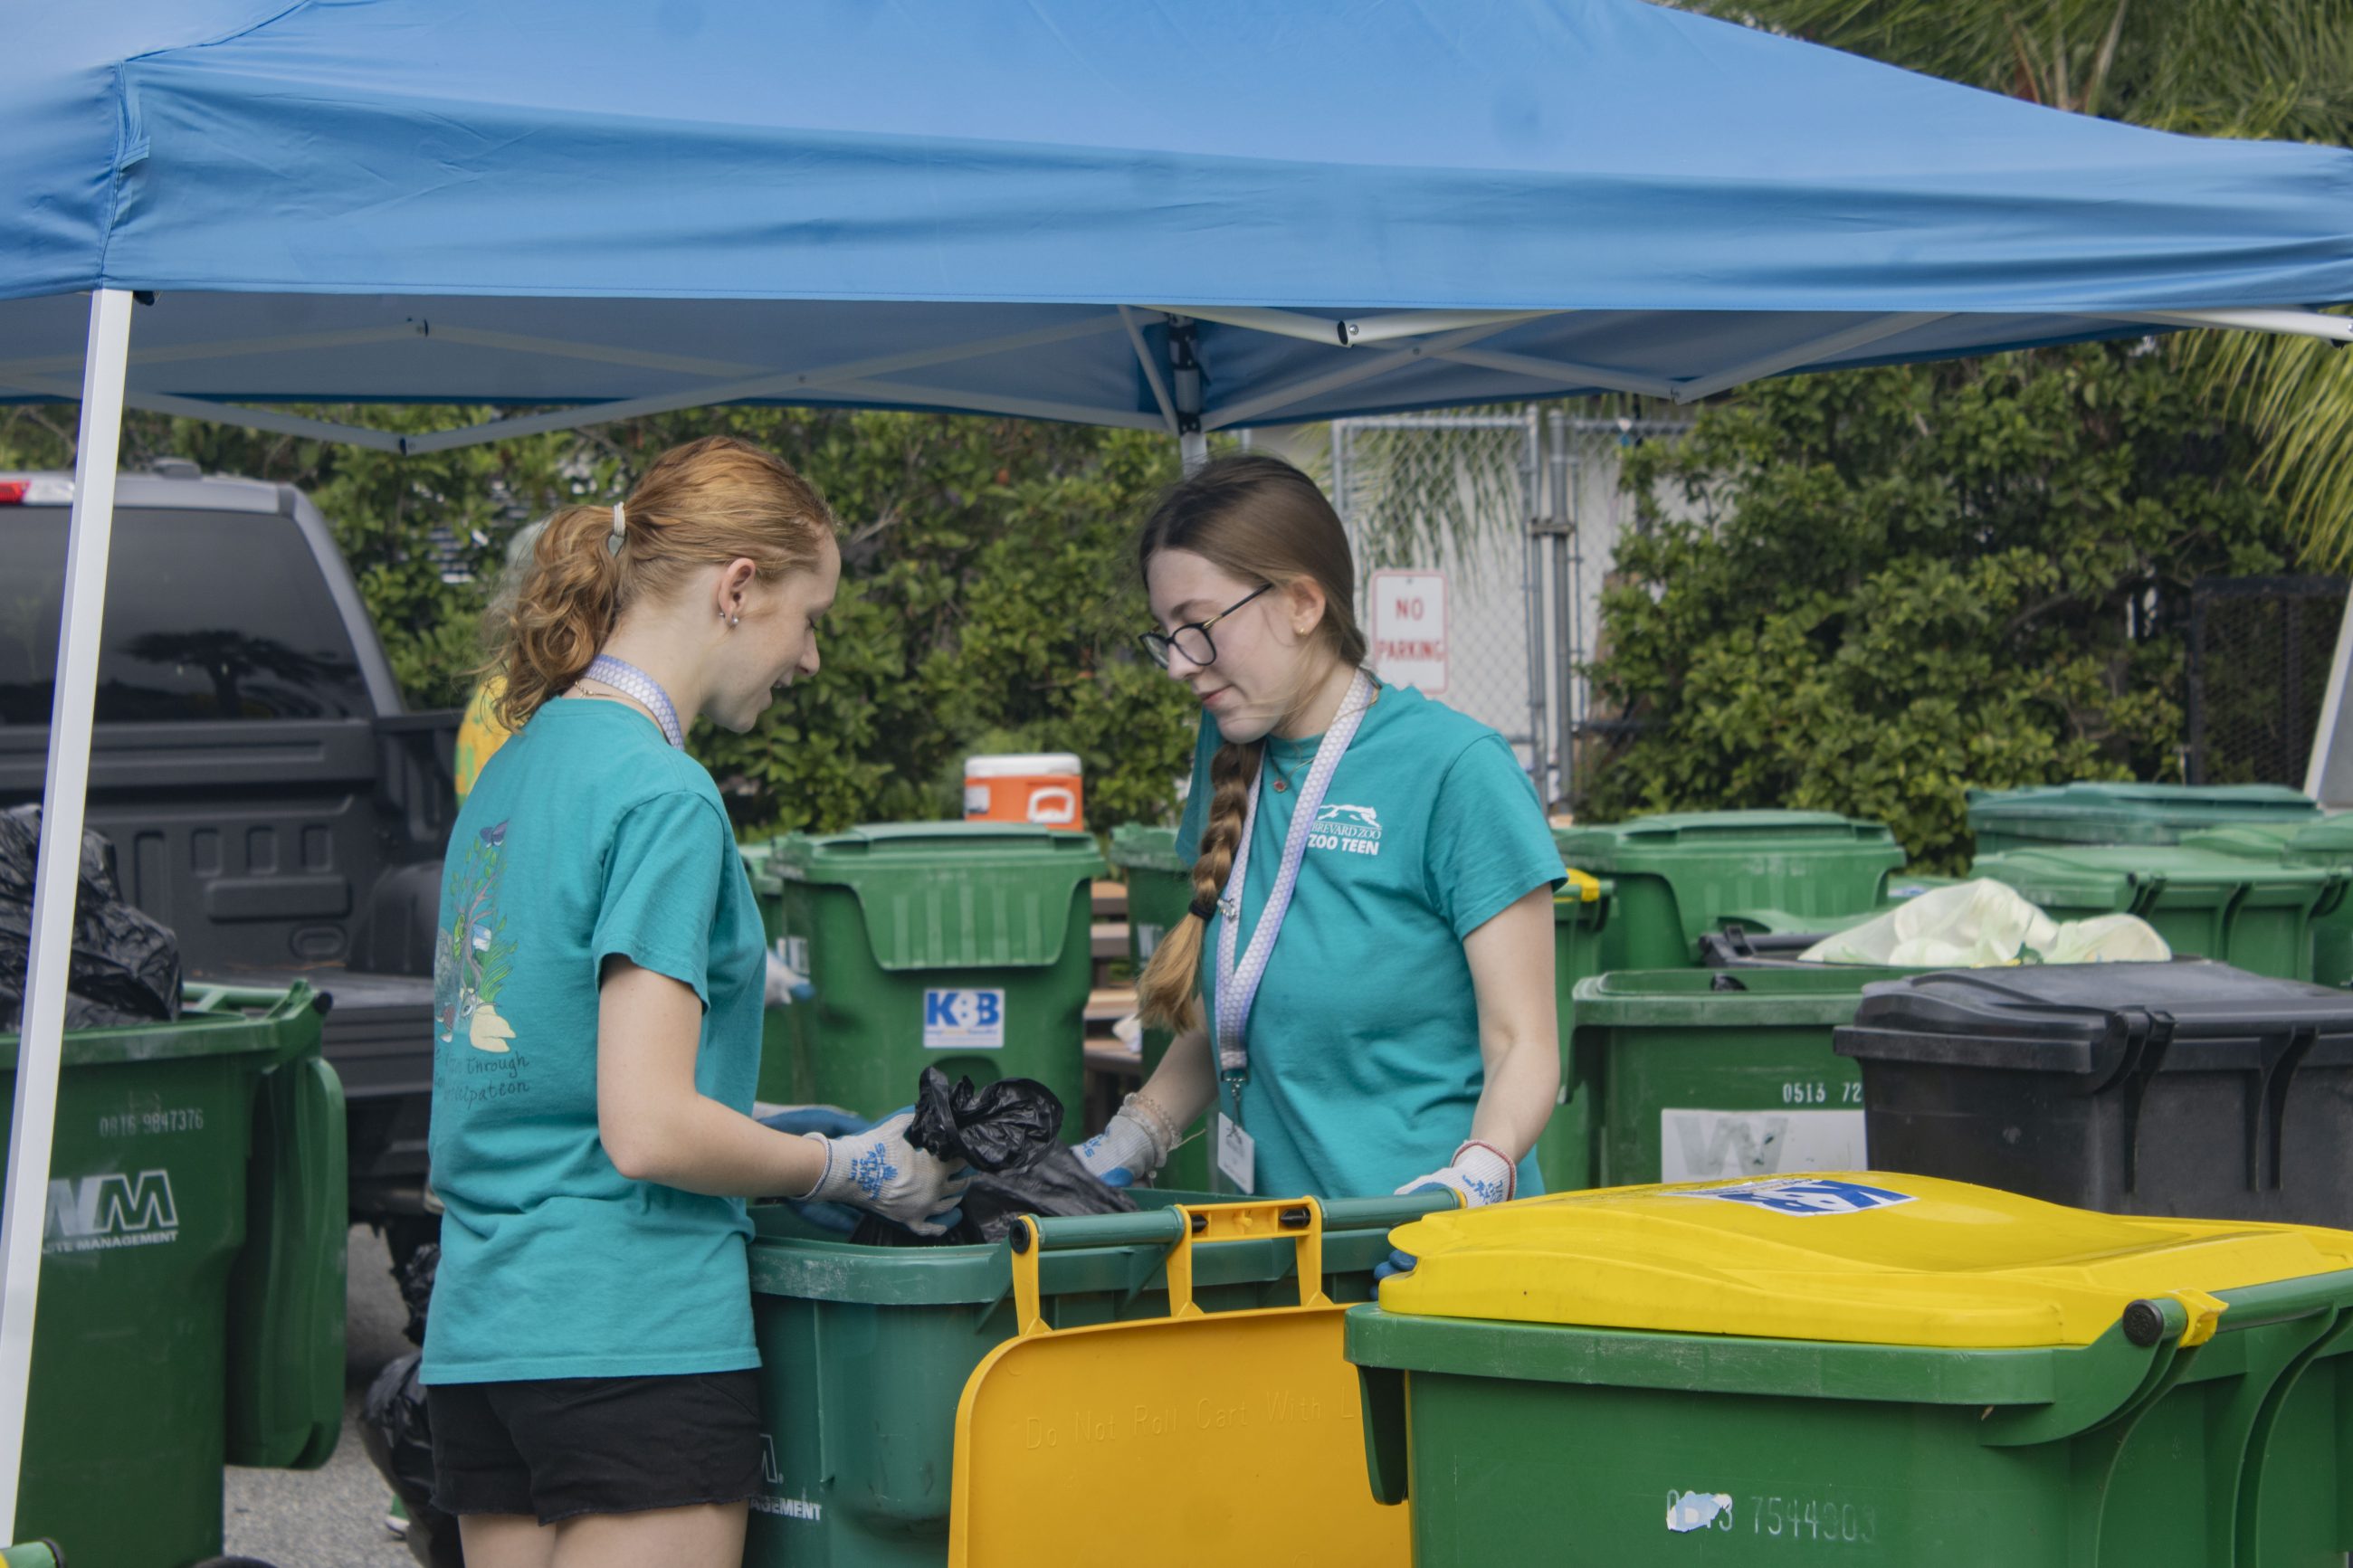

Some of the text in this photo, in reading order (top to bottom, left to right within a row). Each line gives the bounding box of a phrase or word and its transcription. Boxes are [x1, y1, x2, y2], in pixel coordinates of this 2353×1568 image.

[1396, 597, 1424, 621] NO
[1376, 640, 1444, 662] PARKING
[1308, 833, 1379, 856] ZOO TEEN
[1358, 827, 1382, 840] ZOO
[466, 1050, 529, 1079] through
[78, 1231, 179, 1251] MANAGEMENT
[1026, 1416, 1057, 1450] Do
[1074, 1410, 1116, 1444] Not
[1133, 1404, 1177, 1437] Roll
[1196, 1397, 1248, 1430] Cart
[1266, 1390, 1322, 1425] With
